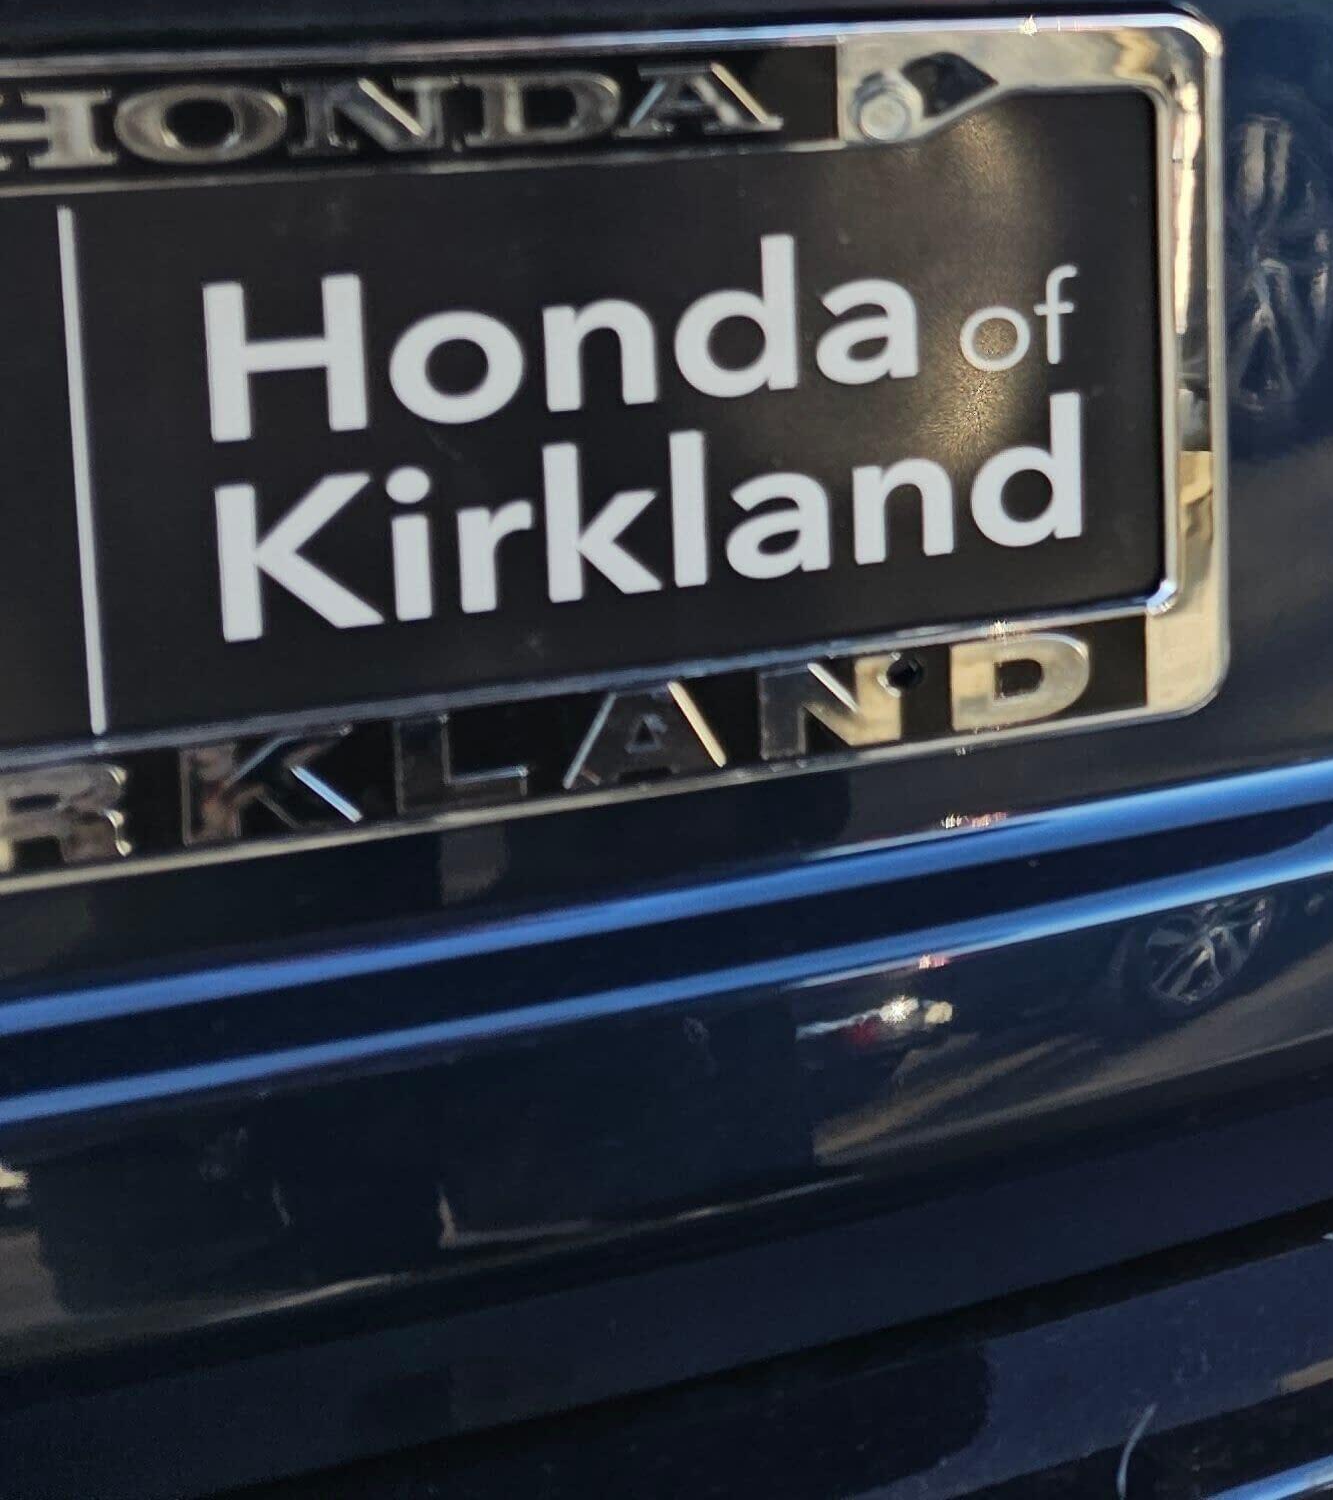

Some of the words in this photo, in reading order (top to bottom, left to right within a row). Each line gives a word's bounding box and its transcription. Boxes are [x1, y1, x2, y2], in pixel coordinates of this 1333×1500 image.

[0, 63, 784, 171] HONDA
[202, 234, 921, 443] Honda
[958, 265, 1077, 374] of
[214, 391, 1084, 643] Kirkland
